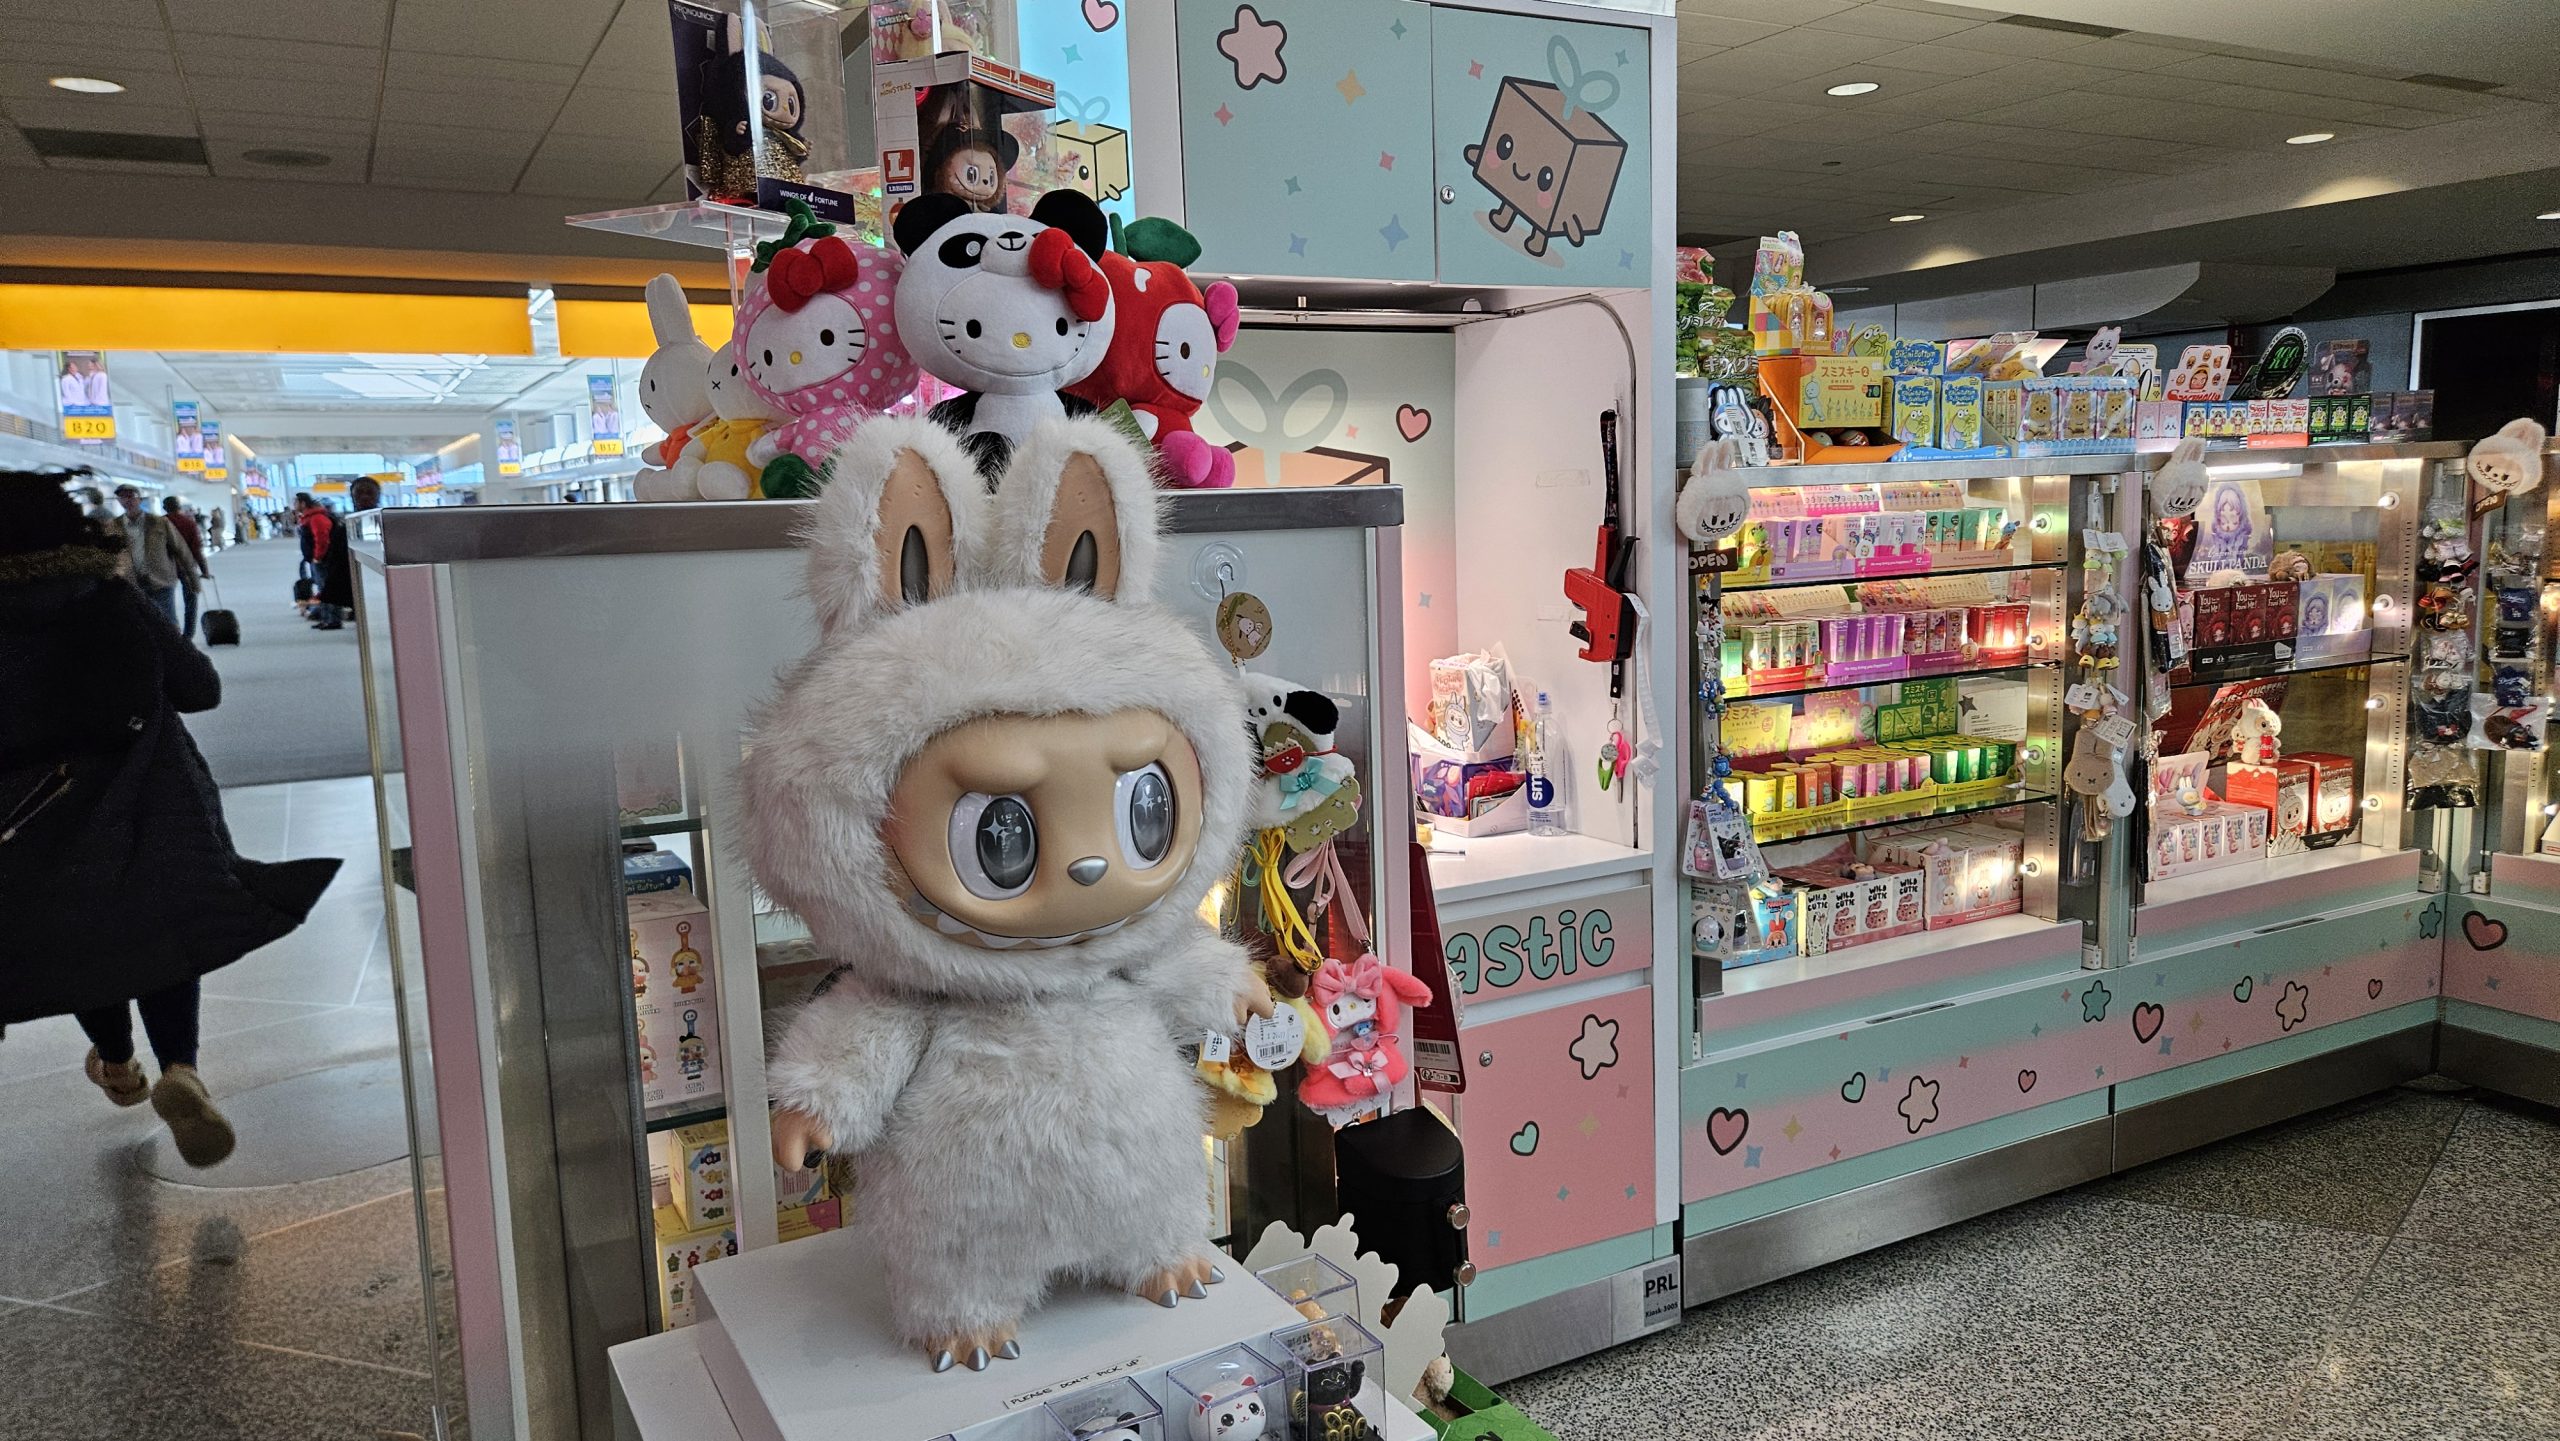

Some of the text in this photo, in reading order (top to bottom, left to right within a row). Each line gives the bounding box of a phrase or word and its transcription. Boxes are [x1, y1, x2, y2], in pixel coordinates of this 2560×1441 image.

[673, 3, 715, 21] PRONOUNCE
[880, 82, 912, 98] MONSTERS
[881, 80, 893, 90] THE
[887, 152, 911, 178] L
[779, 189, 800, 200] WINGS
[814, 196, 839, 207] FORTUNE
[1821, 366, 1860, 377] スミスキー
[72, 422, 106, 434] B20
[2475, 494, 2498, 513] OPEN
[1689, 553, 1728, 570] OPEN
[2188, 556, 2269, 575] SKULLPANDA
[2235, 590, 2248, 603] You
[2268, 587, 2279, 600] You
[2200, 594, 2211, 607] You
[1904, 684, 1930, 695] スミスキー
[1722, 705, 1765, 721] スミスキー
[1900, 878, 1918, 887] WILD
[1869, 884, 1887, 894] WILD
[1899, 885, 1918, 895] CUTIE
[1808, 893, 1828, 903] WILD
[1836, 891, 1855, 901] WILD
[1868, 893, 1887, 902] CUTIE
[1808, 901, 1829, 911] CUTIE
[1835, 899, 1855, 909] CUTIE
[1645, 1273, 1678, 1298] PRL
[1645, 1307, 1661, 1318] Kiosk
[1010, 1388, 1052, 1405] PLEASE
[1060, 1375, 1090, 1388] DON'T
[1096, 1365, 1123, 1377] PICK
